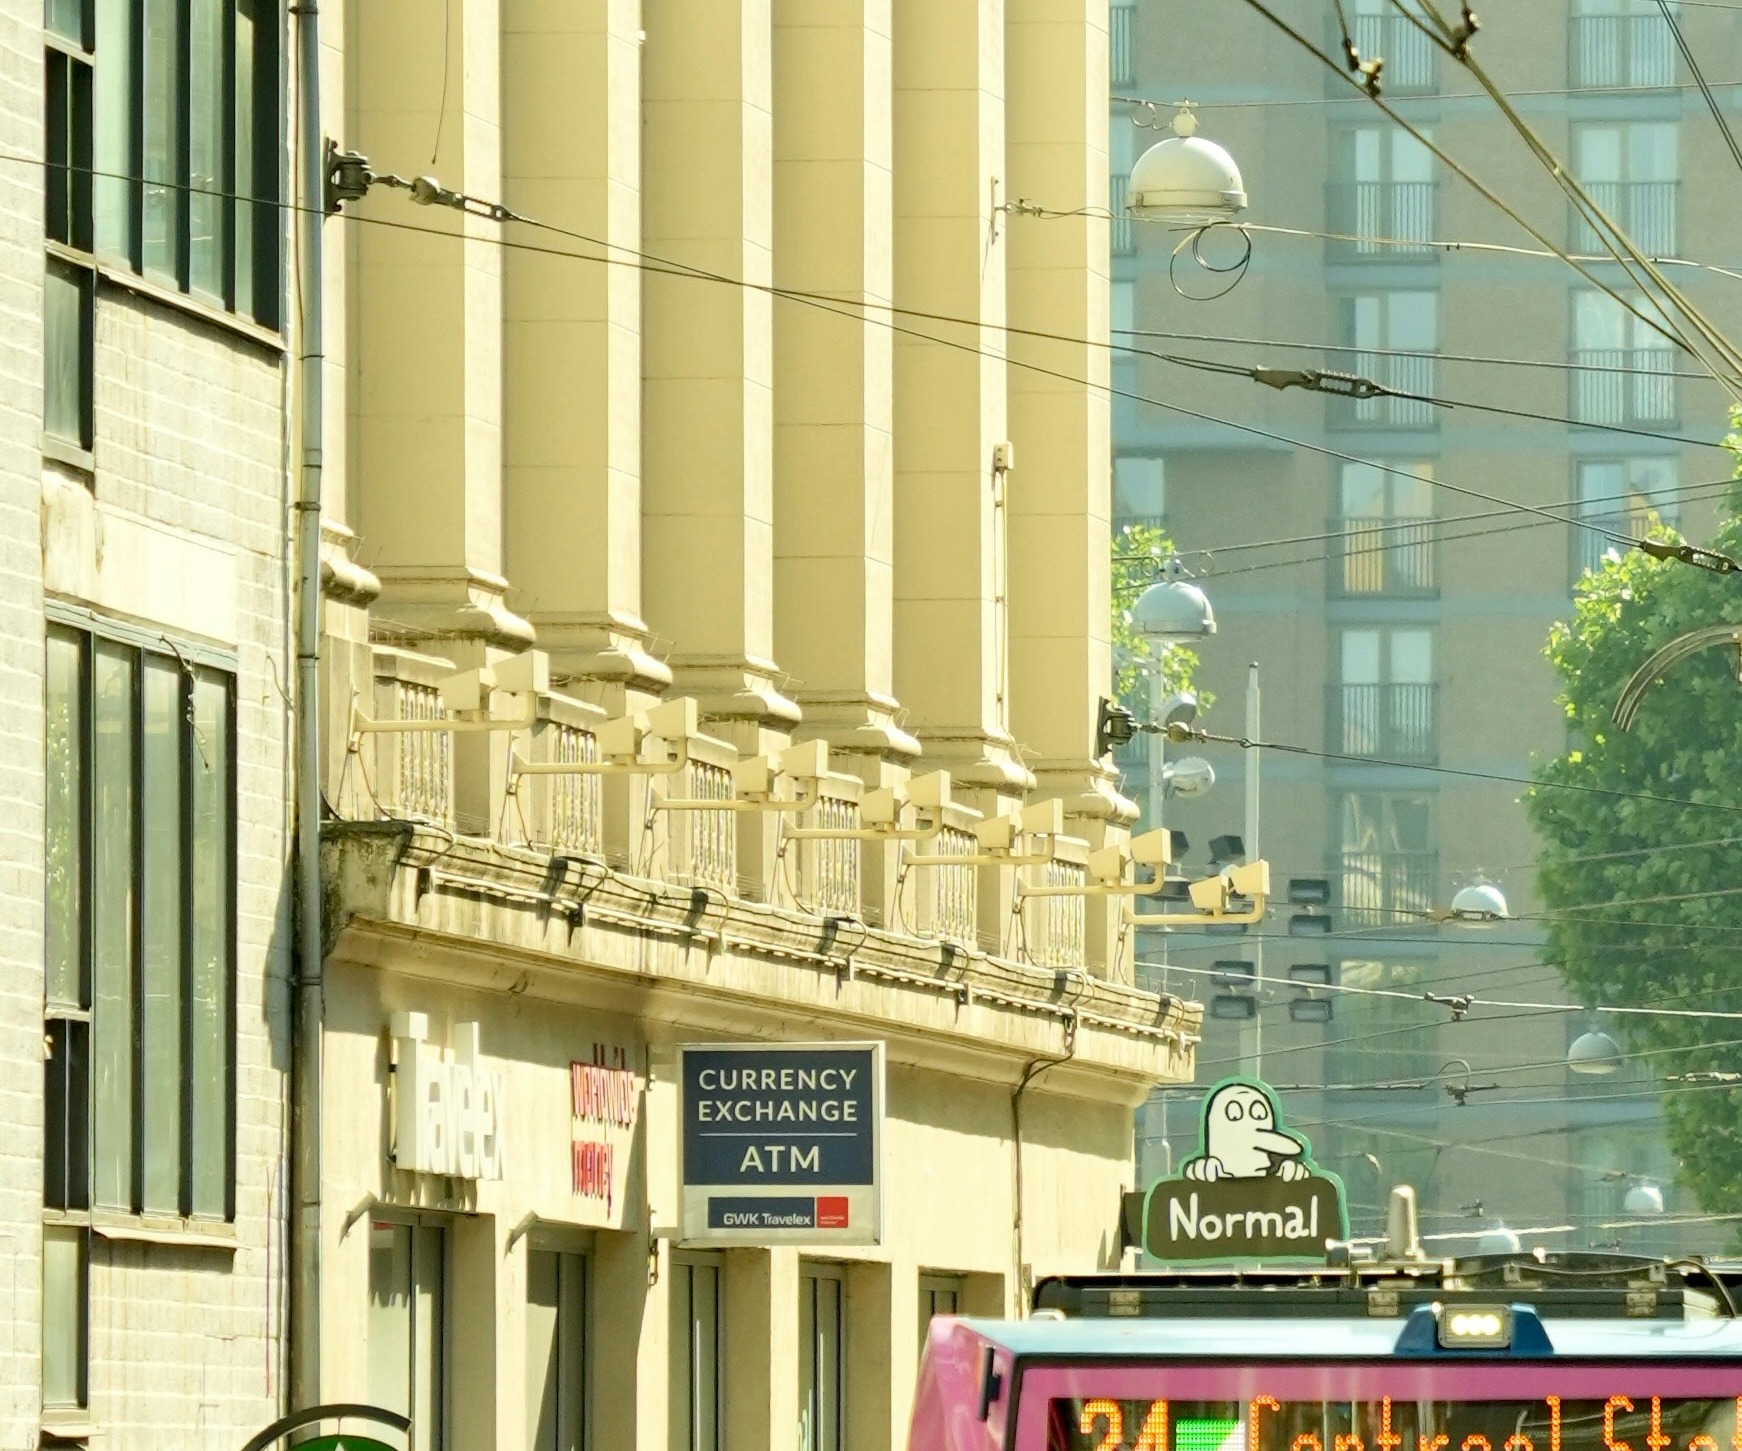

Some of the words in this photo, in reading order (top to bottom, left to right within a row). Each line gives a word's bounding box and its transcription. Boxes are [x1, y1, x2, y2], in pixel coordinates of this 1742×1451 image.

[699, 1069, 857, 1090] CURRENCY
[698, 1101, 858, 1122] EXCHANGE
[739, 1145, 820, 1173] ATM
[723, 1213, 759, 1225] GWK
[762, 1213, 811, 1225] Travelex
[1169, 1192, 1318, 1241] Normal
